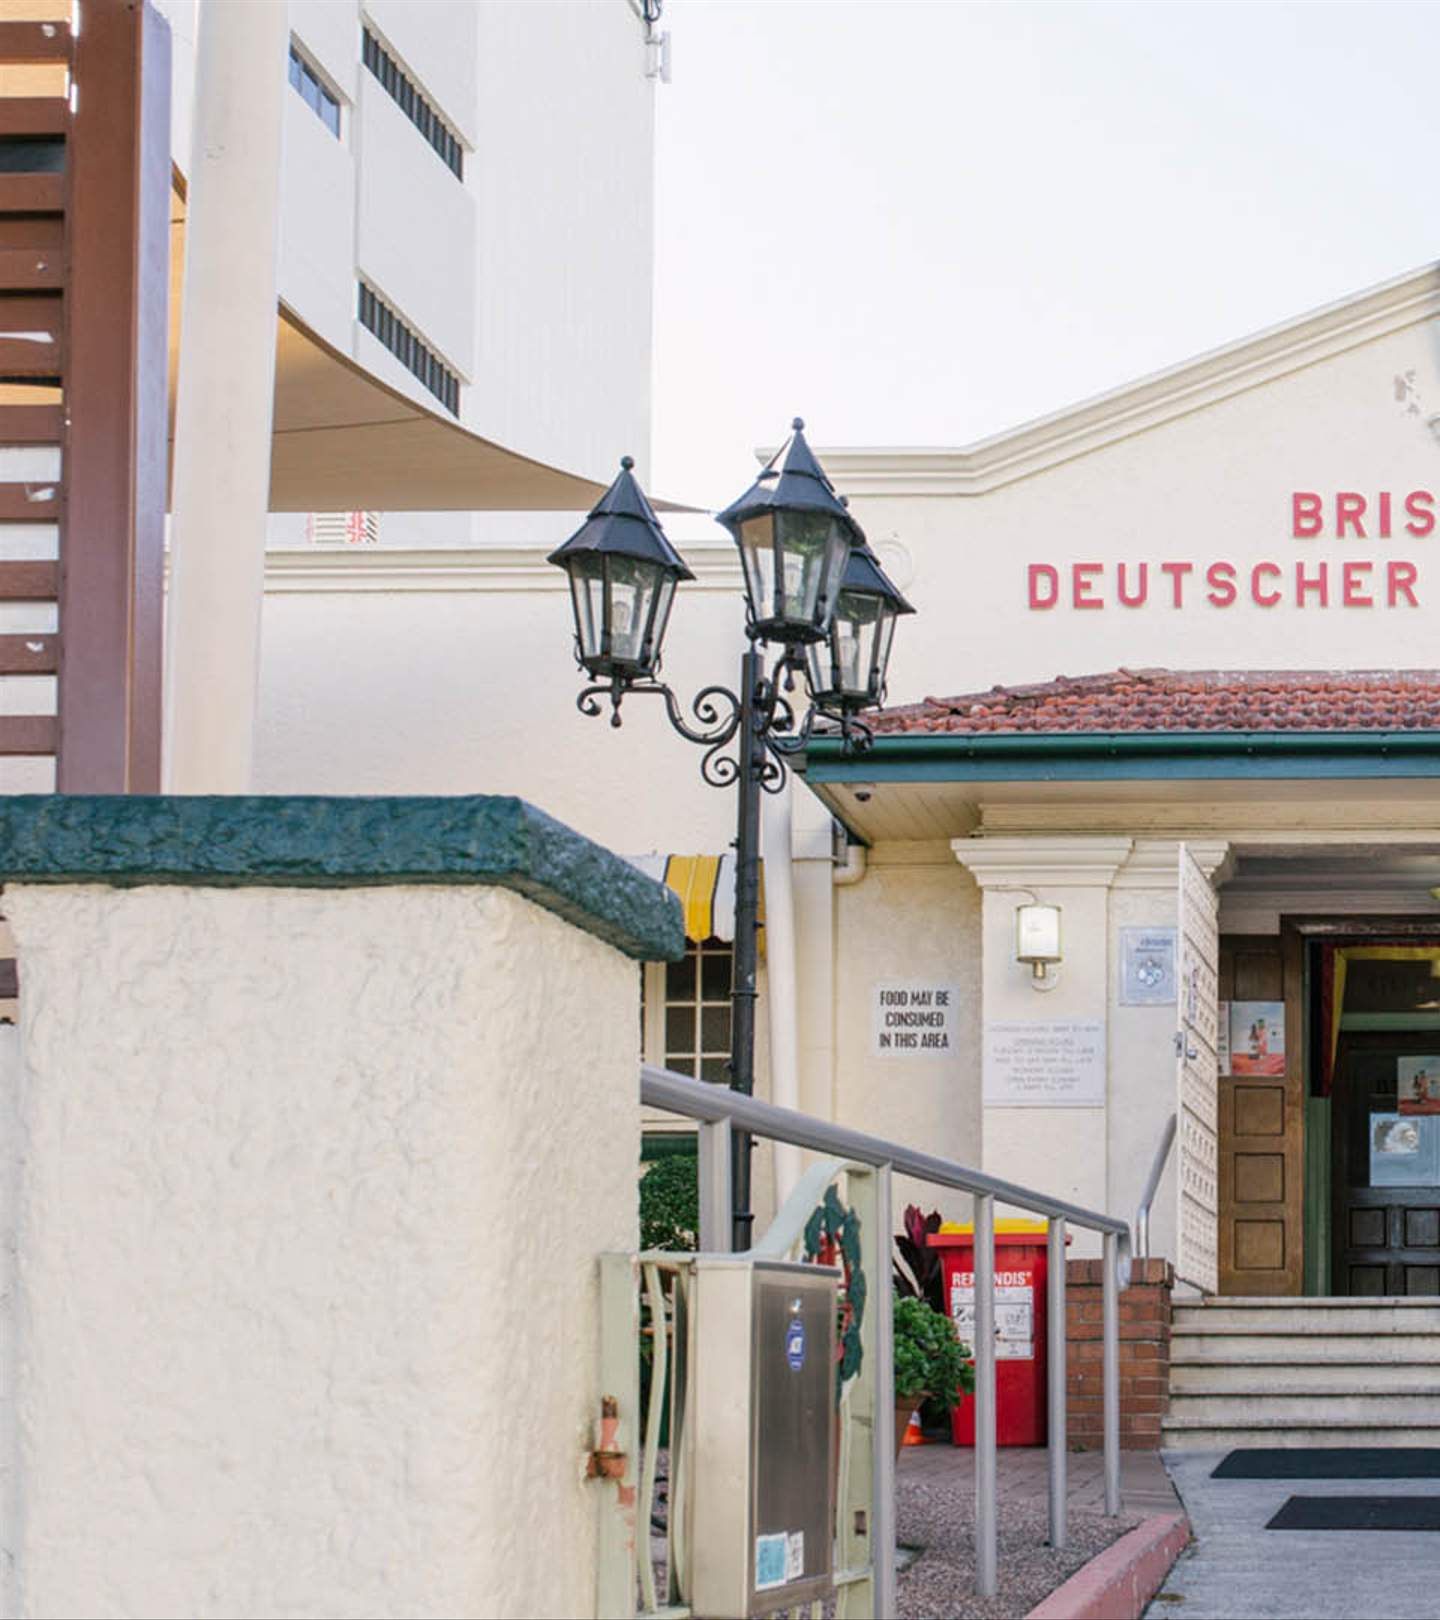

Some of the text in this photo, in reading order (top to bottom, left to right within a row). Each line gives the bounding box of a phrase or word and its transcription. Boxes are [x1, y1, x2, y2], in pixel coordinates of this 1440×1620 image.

[1028, 561, 1418, 610] DEUTSCHER
[880, 990, 950, 1006] FOOD MAY BE
[885, 1011, 944, 1027] CONSUMED
[879, 1032, 949, 1048] IN THIS AREA
[952, 1271, 1027, 1287] RENDIS
